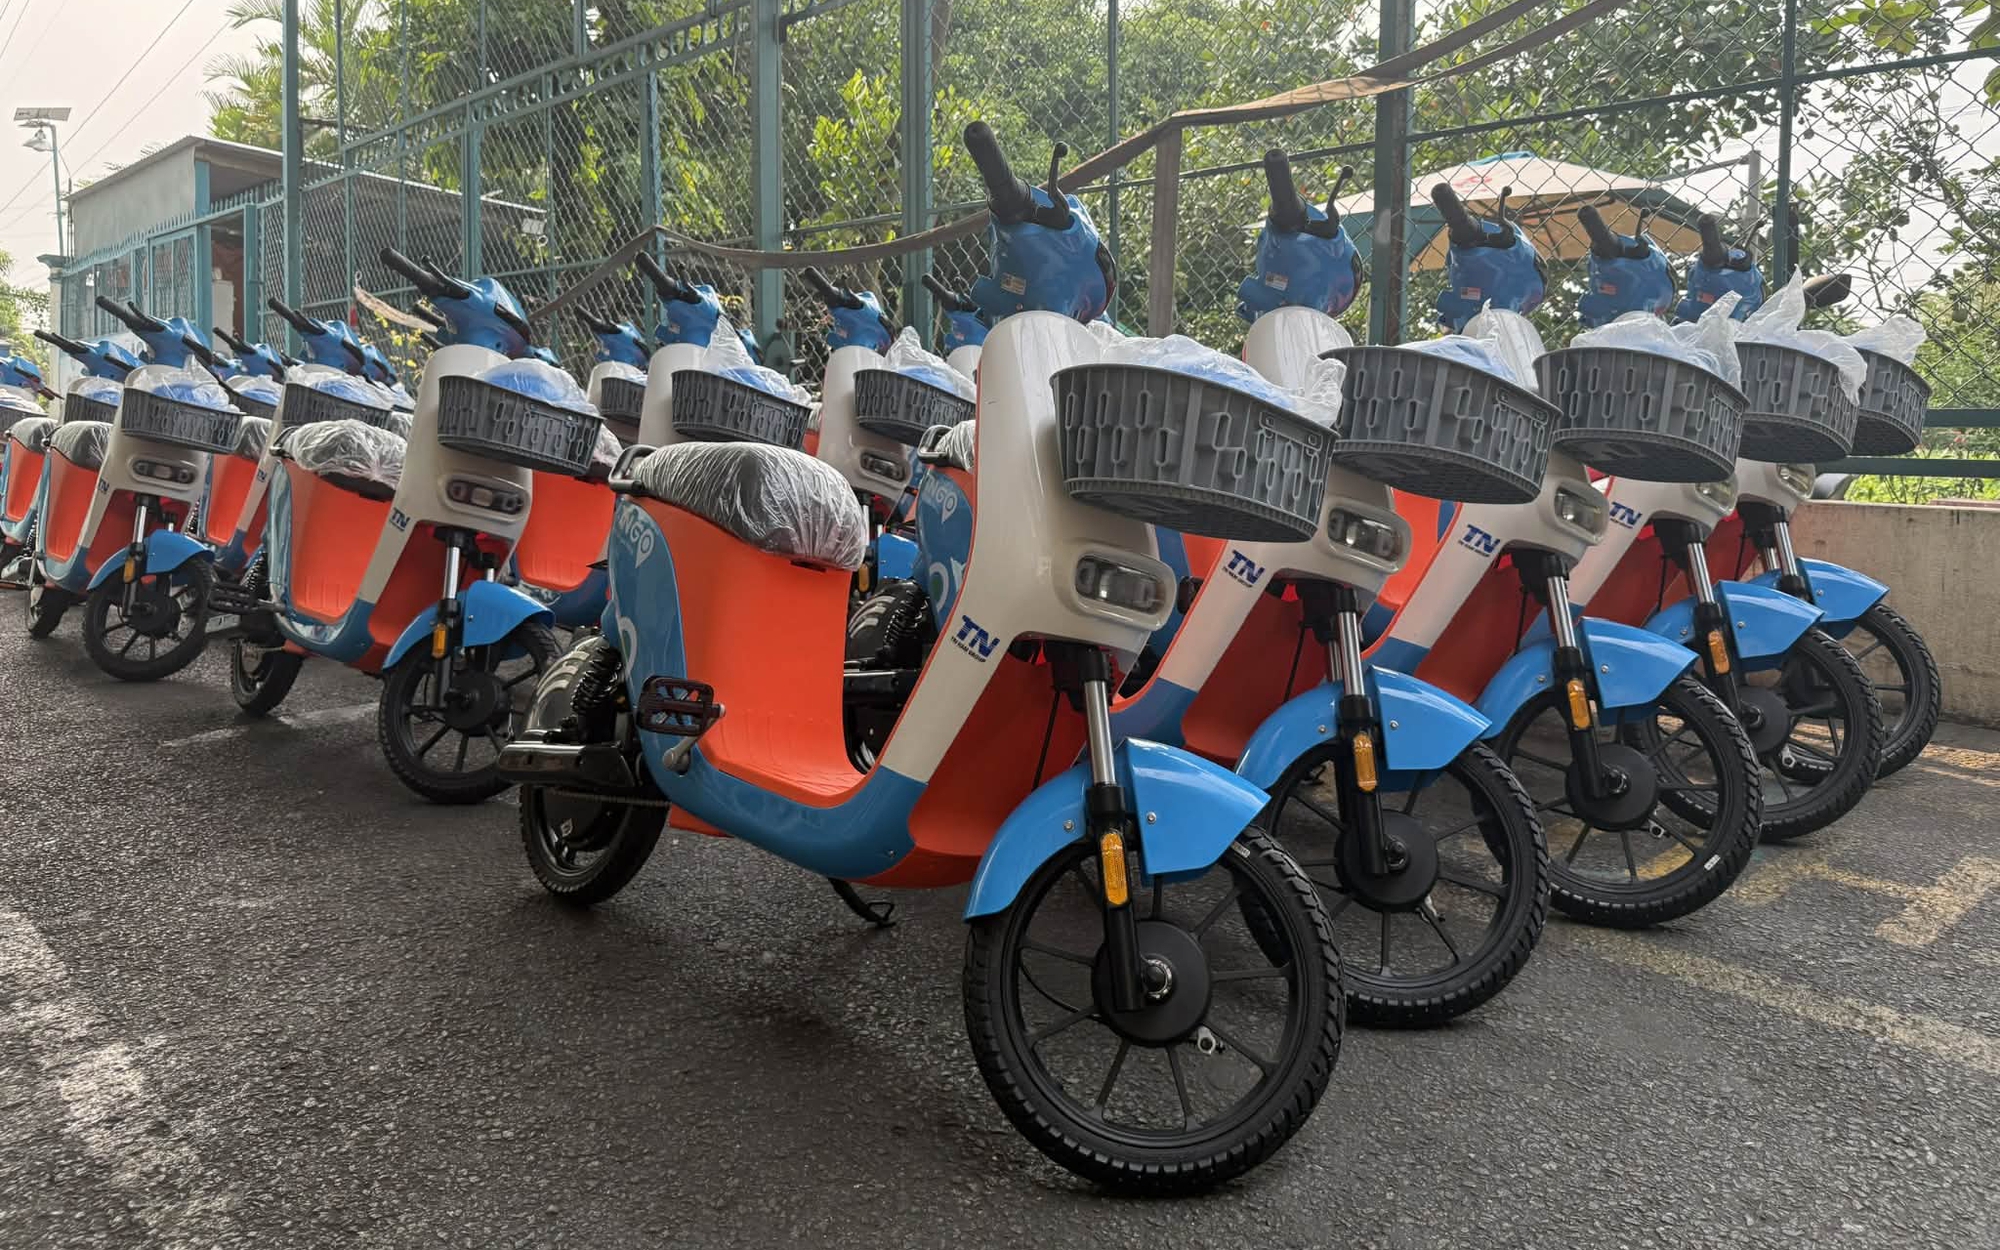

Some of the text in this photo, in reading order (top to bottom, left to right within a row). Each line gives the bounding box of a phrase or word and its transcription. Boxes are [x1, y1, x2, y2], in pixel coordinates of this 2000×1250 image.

[392, 507, 411, 528] TN
[1609, 502, 1643, 526] TN
[1462, 524, 1501, 554] TN
[1227, 549, 1265, 584] TN
[957, 615, 1000, 657] TN
